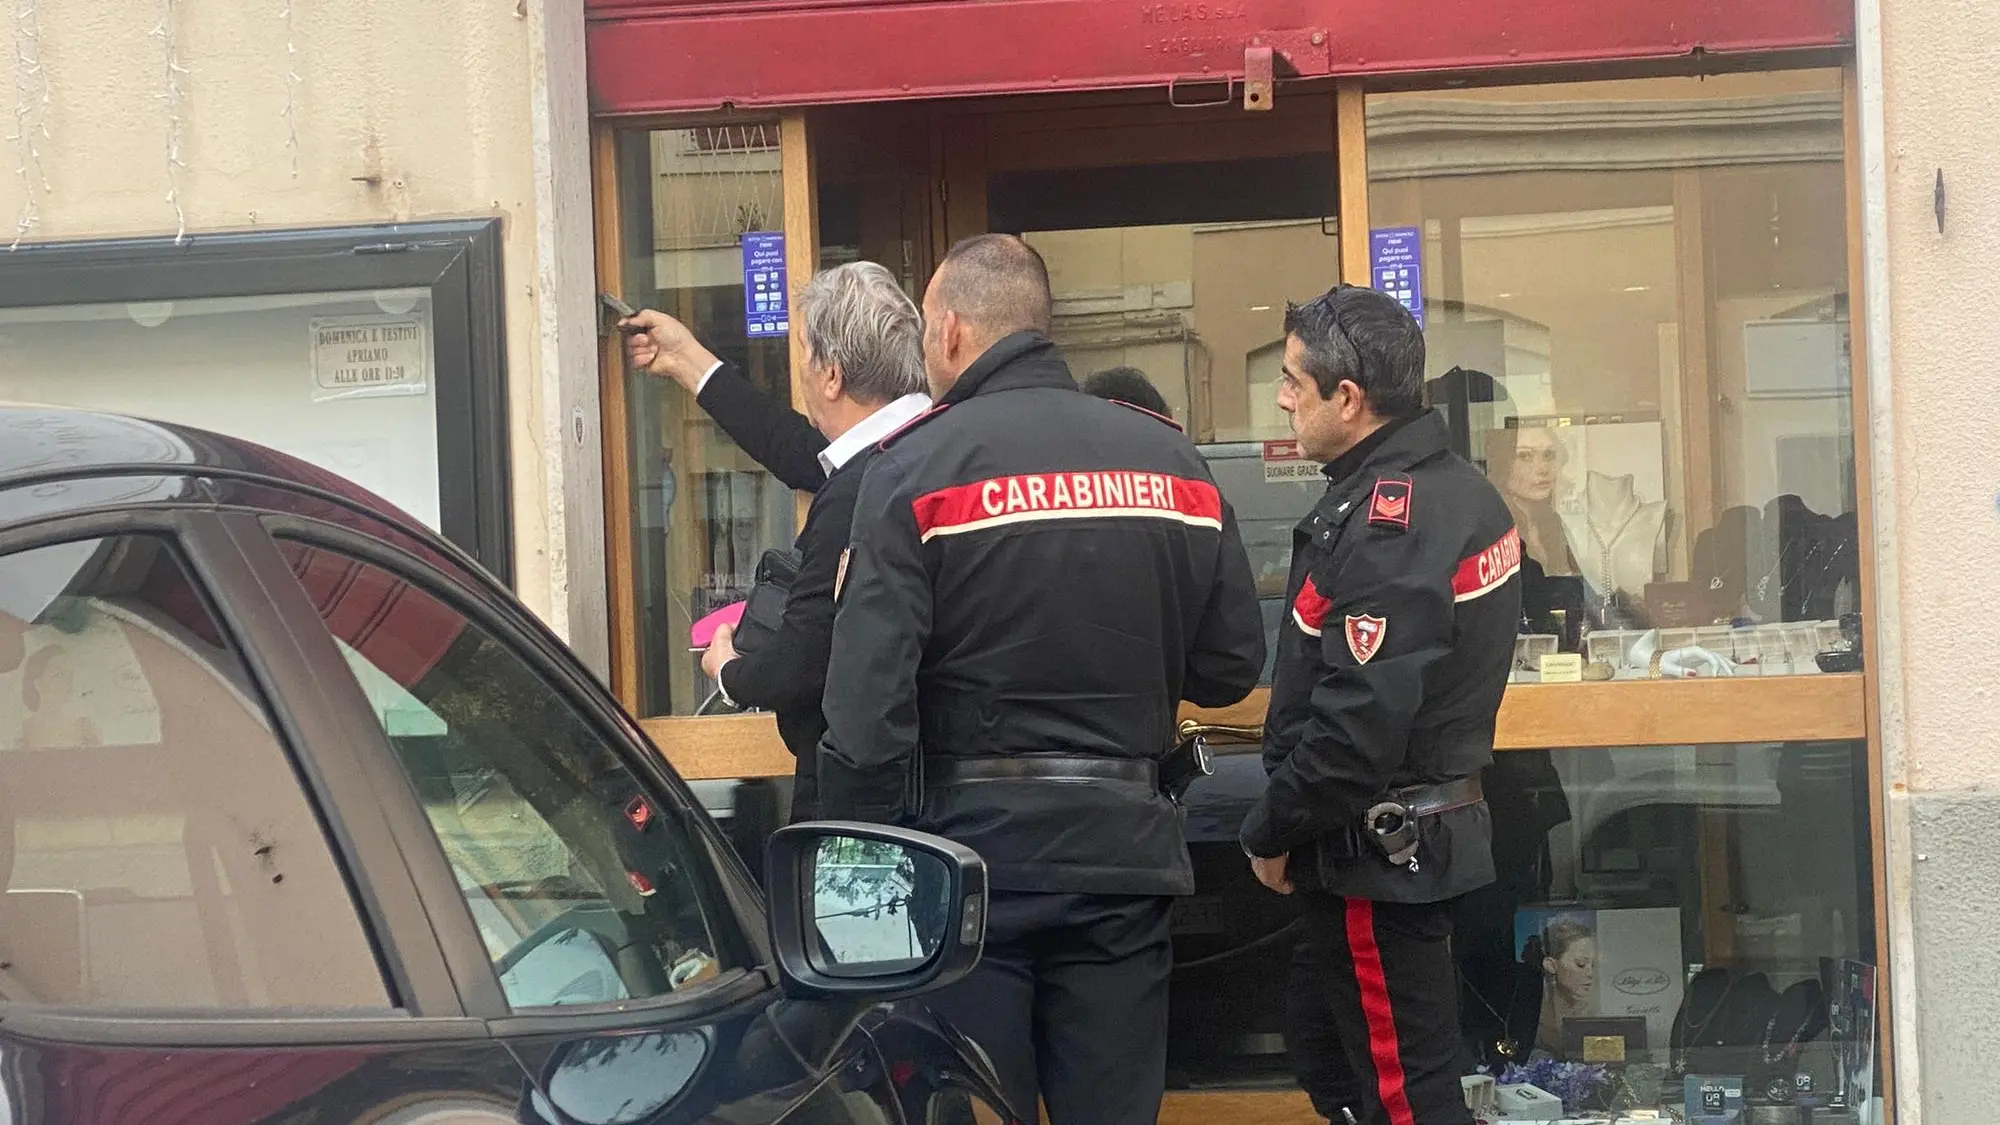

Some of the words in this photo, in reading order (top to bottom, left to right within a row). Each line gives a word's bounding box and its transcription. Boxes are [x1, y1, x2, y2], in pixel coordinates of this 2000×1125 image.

[319, 330, 367, 345] DOMENICA
[371, 328, 378, 342] E
[382, 326, 417, 342] FESTIVI
[346, 348, 388, 363] APRIAMO
[334, 368, 357, 383] ALLE
[361, 367, 381, 381] ORE
[982, 474, 1175, 516] CARABINIERI
